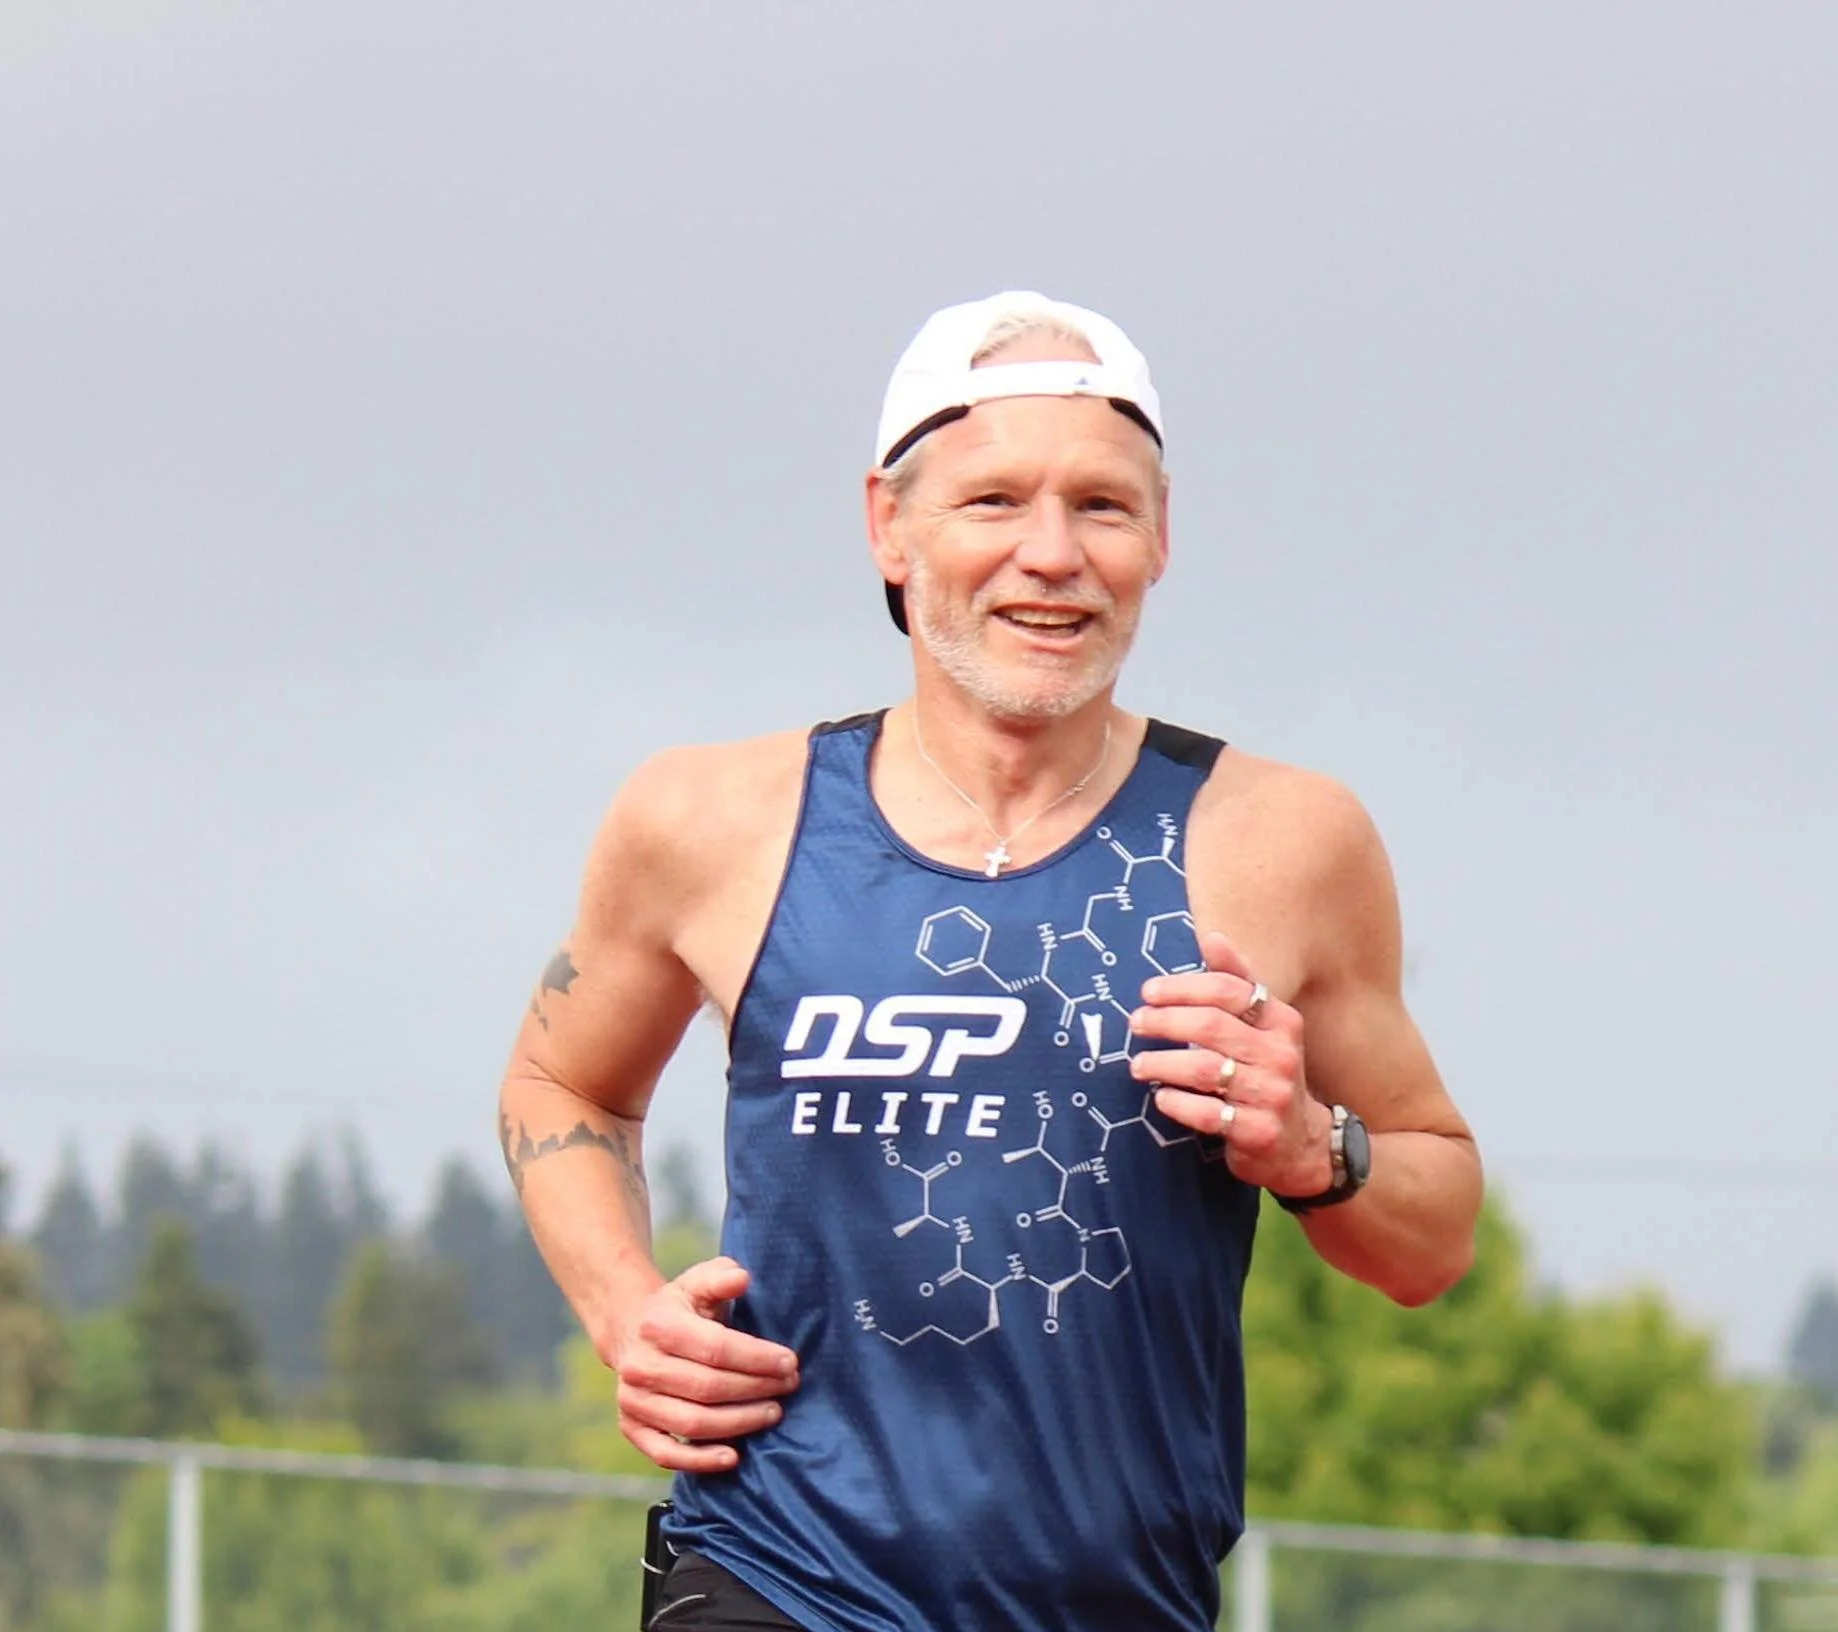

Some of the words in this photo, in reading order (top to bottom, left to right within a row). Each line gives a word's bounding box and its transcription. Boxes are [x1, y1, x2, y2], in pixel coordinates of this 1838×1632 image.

[1114, 886, 1134, 911] NH
[1037, 923, 1058, 949] HN
[1102, 951, 1117, 966] O
[781, 995, 1027, 1078] DSP
[1053, 1031, 1069, 1046] O
[1079, 1057, 1095, 1073] O
[1072, 1091, 1087, 1107] O
[791, 1091, 1006, 1139] ELITE
[946, 1150, 962, 1166] O
[1016, 1212, 1031, 1228] O
[919, 1282, 934, 1297] O
[1043, 1318, 1059, 1334] O
